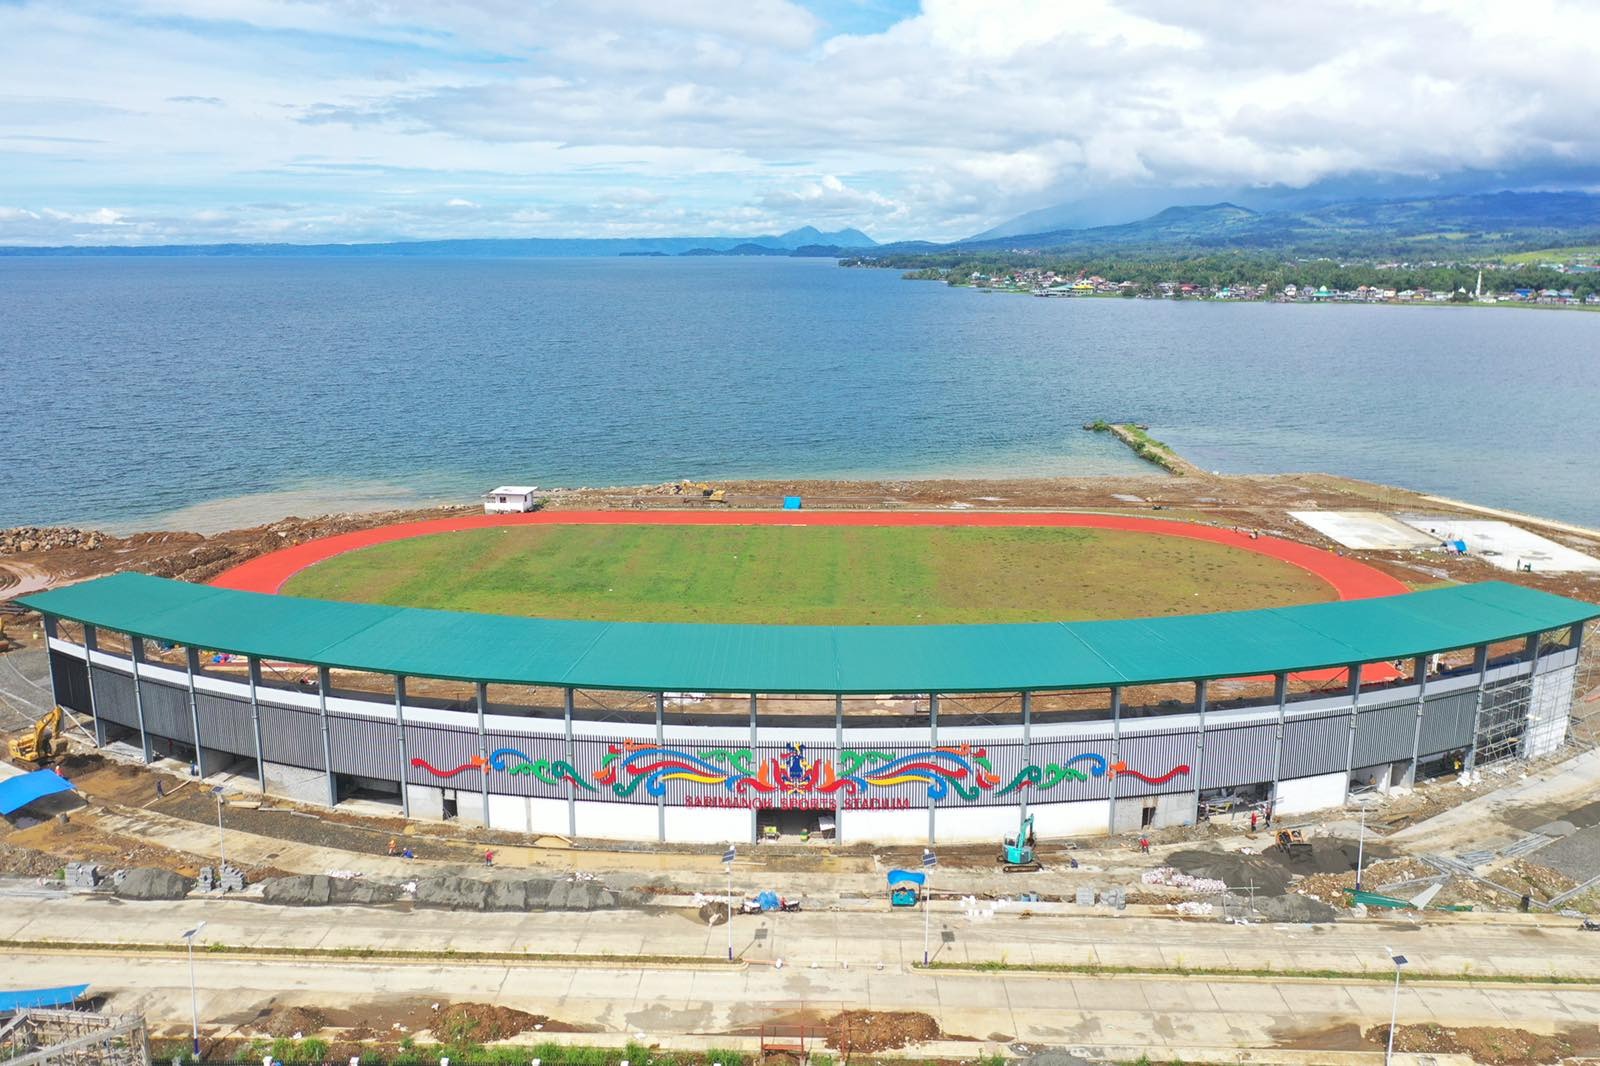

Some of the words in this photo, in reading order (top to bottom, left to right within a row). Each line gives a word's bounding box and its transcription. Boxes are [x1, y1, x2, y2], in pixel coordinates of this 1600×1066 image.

[685, 795, 774, 810] SARIMANOK
[780, 797, 837, 811] SPORTS
[844, 797, 911, 810] STADIUM
